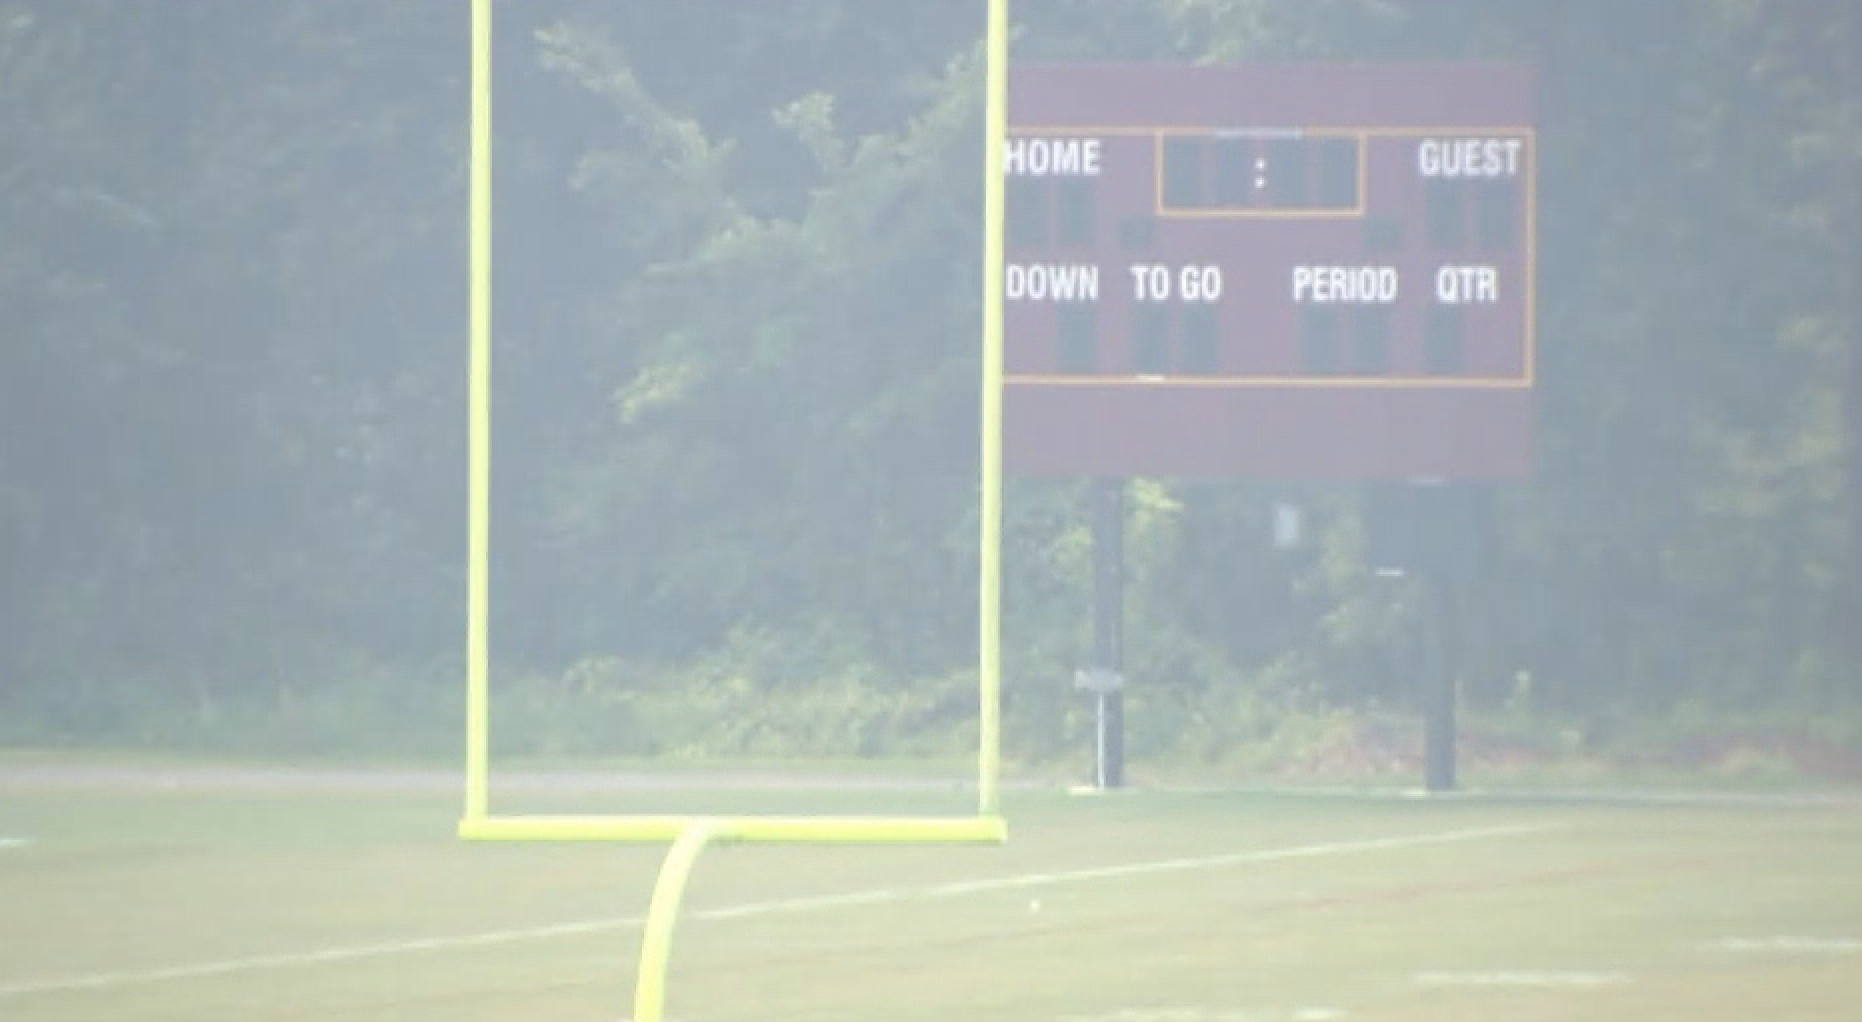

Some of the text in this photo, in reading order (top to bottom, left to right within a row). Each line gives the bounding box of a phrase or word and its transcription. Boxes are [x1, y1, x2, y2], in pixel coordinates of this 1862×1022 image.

[1004, 139, 1101, 175] HOME
[1420, 139, 1521, 176] GUEST
[1006, 265, 1099, 300] DOWN
[1130, 265, 1222, 300] TO GO
[1293, 266, 1398, 301] PERIOD
[1437, 266, 1498, 302] QTR
